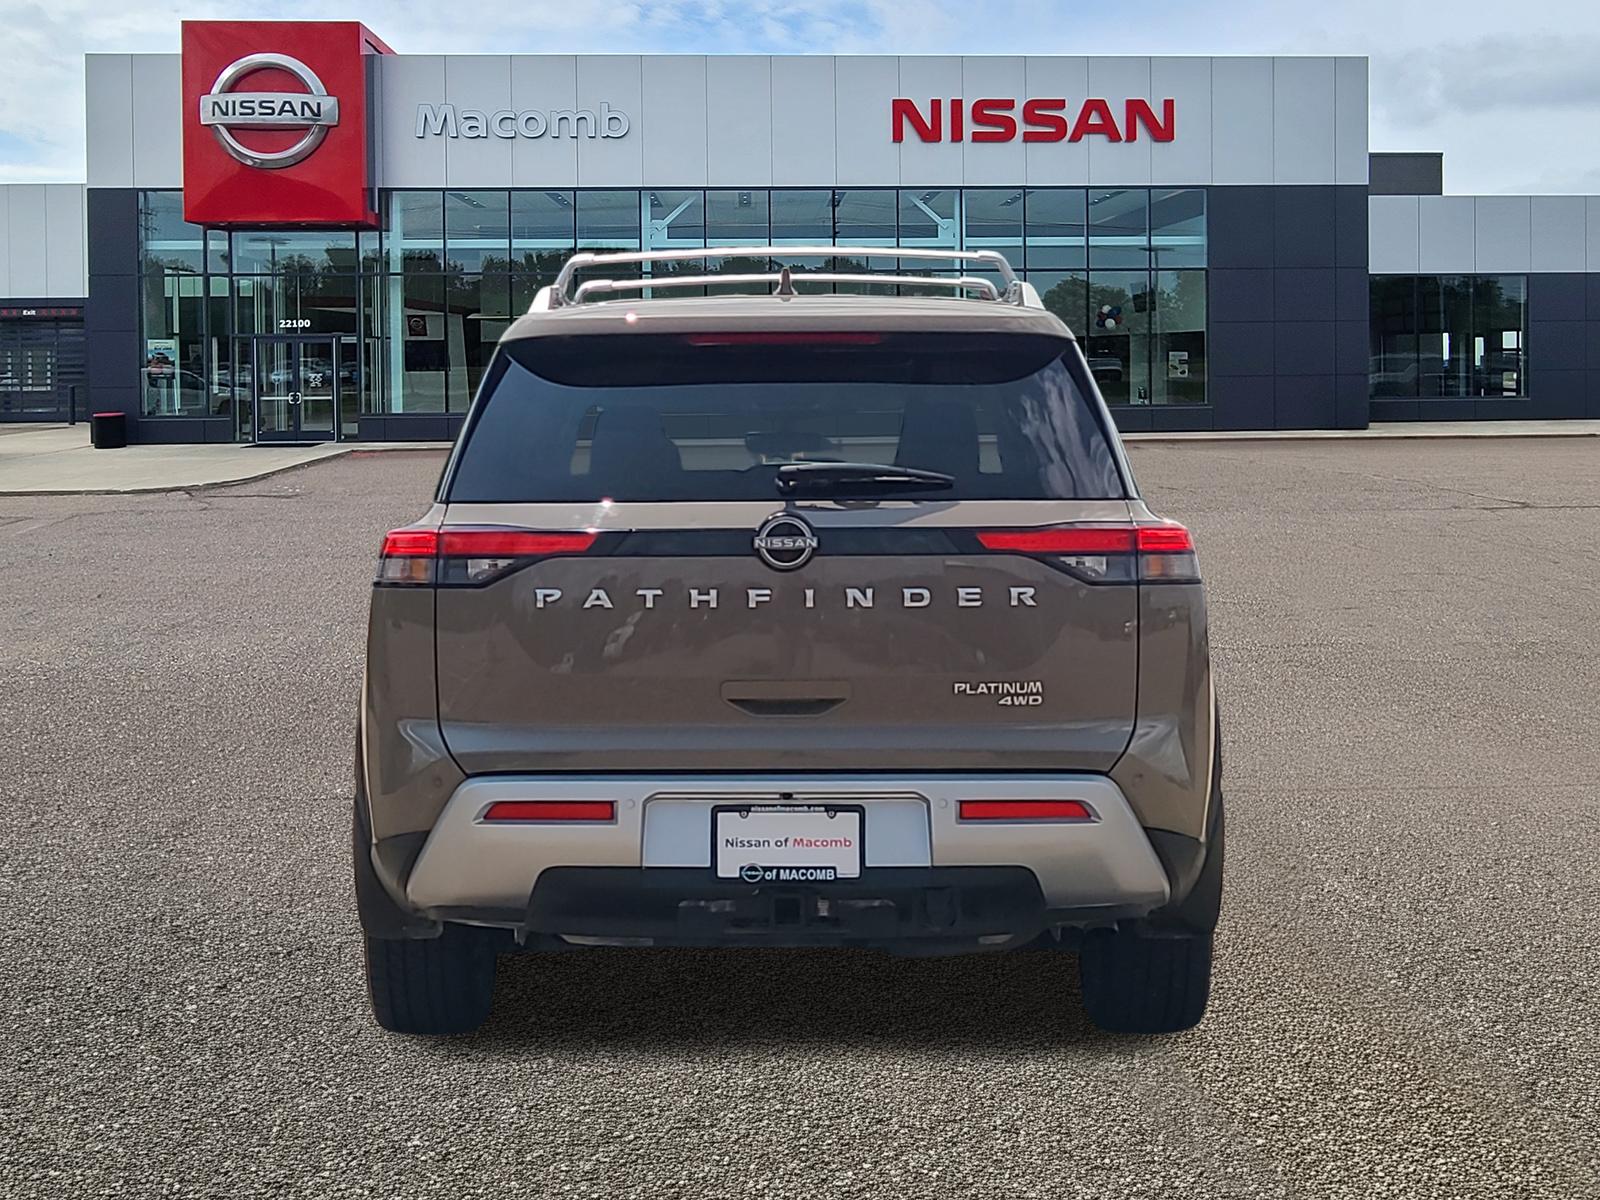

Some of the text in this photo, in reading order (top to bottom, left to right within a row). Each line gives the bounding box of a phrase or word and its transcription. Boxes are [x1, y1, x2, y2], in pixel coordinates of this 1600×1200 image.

[211, 99, 322, 118] NISSAN
[415, 102, 630, 139] Macomb
[892, 97, 1176, 144] NISSAN
[279, 319, 311, 328] 22100
[755, 538, 817, 548] NISSAN
[535, 587, 1037, 609] PATHFINDER
[953, 681, 1043, 695] PLATINUM
[998, 695, 1043, 706] 4WD
[725, 837, 852, 848] Nissan of Macomb
[765, 869, 777, 880] of
[779, 869, 835, 880] MACOMB
